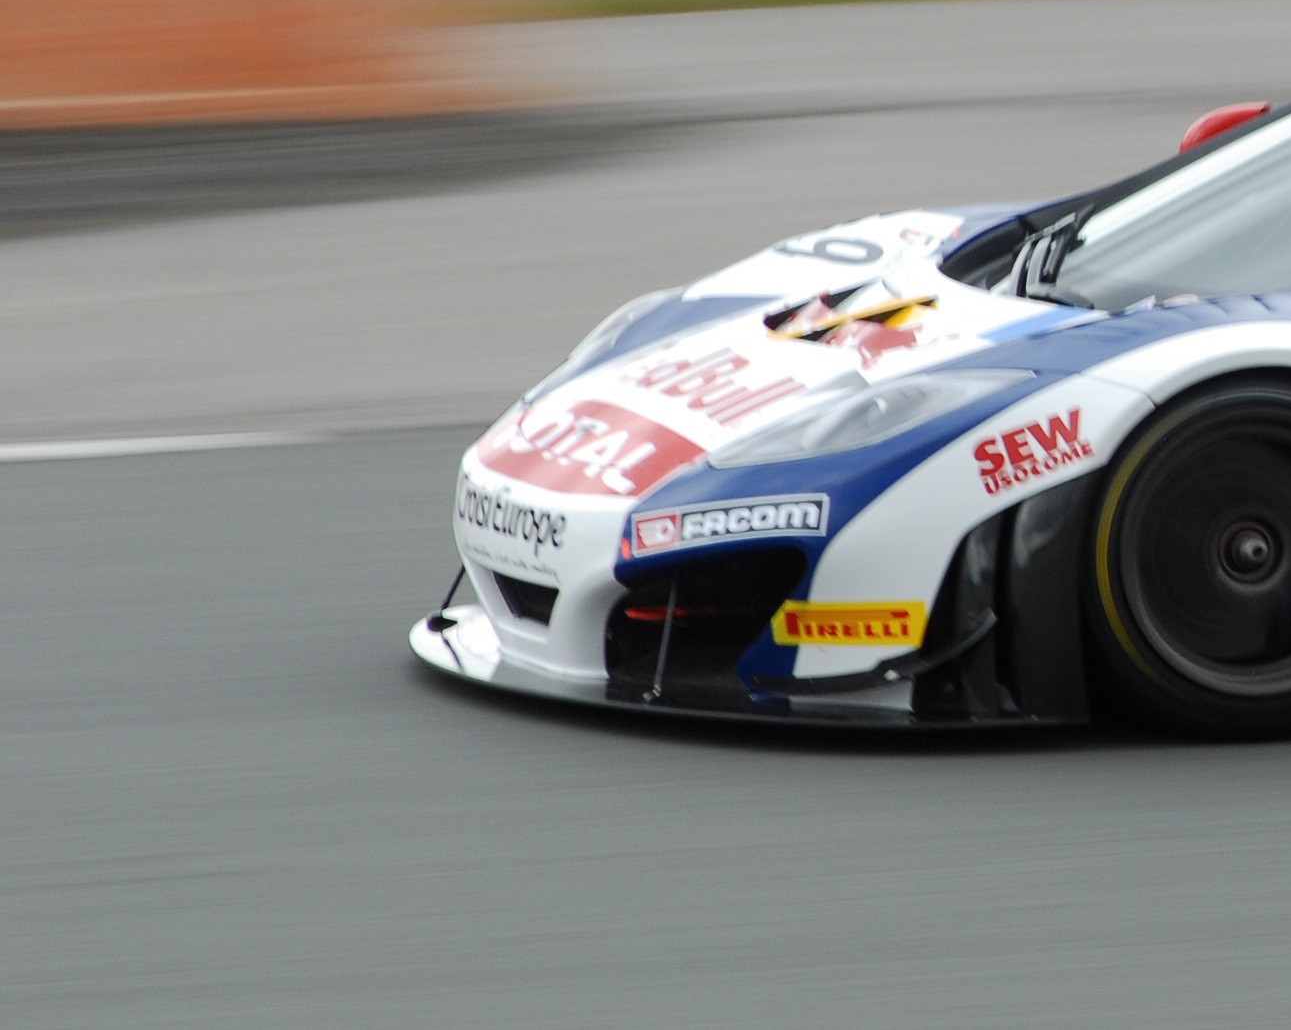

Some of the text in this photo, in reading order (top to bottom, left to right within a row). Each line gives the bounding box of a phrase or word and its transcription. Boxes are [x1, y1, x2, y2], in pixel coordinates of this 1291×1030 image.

[973, 408, 1080, 477] SEW
[681, 501, 821, 540] FACOM
[784, 609, 910, 637] PIRELLI
